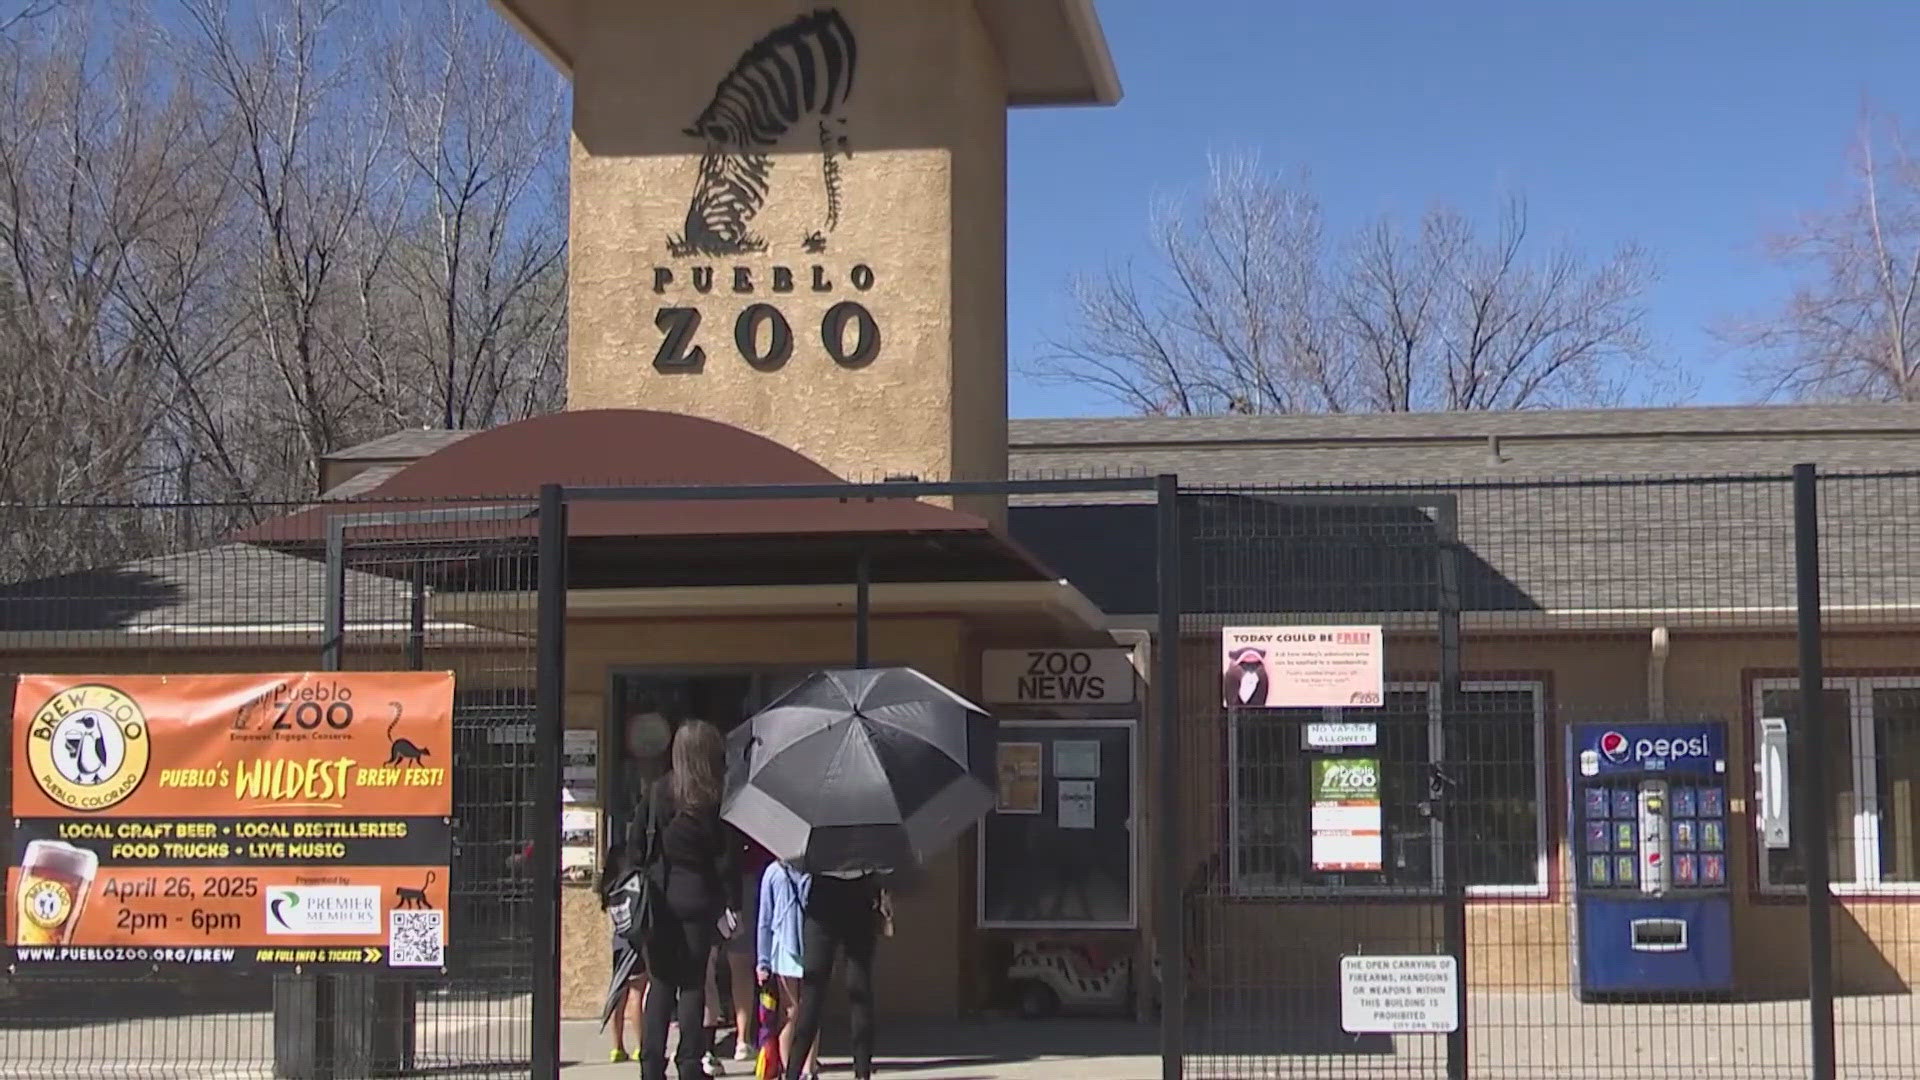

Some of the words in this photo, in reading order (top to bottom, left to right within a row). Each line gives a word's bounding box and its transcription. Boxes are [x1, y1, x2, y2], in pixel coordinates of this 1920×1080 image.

[652, 263, 875, 294] PUEBLO
[652, 300, 881, 375] ZOO
[1233, 634, 1273, 643] TODAY
[1276, 633, 1316, 642] COULD
[1320, 633, 1333, 642] BE
[1027, 652, 1092, 676] ZOO
[273, 681, 352, 701] Pueblo
[1018, 676, 1105, 700] NEWS
[33, 690, 88, 741] BREW
[103, 693, 142, 740] ZOO
[1312, 725, 1327, 733] NO
[1635, 733, 1710, 761] pepsi
[159, 760, 229, 787] PUEBLO'S
[235, 756, 357, 800] WILDEST
[356, 768, 402, 786] BREW
[404, 768, 444, 786] FEST!
[81, 773, 137, 807] COLORADO
[59, 823, 114, 839] LOCAL
[117, 823, 173, 839] CRAFT
[176, 823, 217, 838] BEER
[235, 822, 290, 838] LOCAL
[293, 822, 408, 838] DISTILLERIES
[112, 843, 160, 859] FOOD
[163, 843, 229, 858] TRUCKS
[249, 842, 285, 858] LIVE
[288, 842, 346, 858] MUSIC
[103, 877, 157, 903] April
[164, 877, 195, 901] 26,
[203, 877, 258, 898] 2025
[307, 897, 373, 910] PREMIER
[117, 908, 167, 935] 2pm
[191, 908, 241, 935] 6pm
[306, 911, 374, 921] MEMBERS
[16, 948, 235, 964] WWW.PUEBLOZOO.ORG/BREW
[256, 949, 274, 962] FOR
[275, 949, 294, 962] FULL
[295, 949, 317, 962] INFO
[317, 949, 326, 962] &
[328, 949, 362, 962] TICKETS
[1346, 960, 1362, 970] THE
[1366, 960, 1389, 970] OPEN
[1392, 960, 1436, 970] CARRYING
[1440, 960, 1451, 970] OF
[1349, 973, 1397, 983] FIREARMS,
[1400, 973, 1449, 982] HANDGUNS
[1352, 986, 1365, 994] OR
[1369, 985, 1412, 994] WEAPONS
[1416, 985, 1446, 994] WITHIN
[1360, 998, 1380, 1007] THIS
[1384, 998, 1426, 1007] BUILDING
[1430, 998, 1439, 1007] IS
[1373, 1011, 1426, 1020] PROHIBITED
